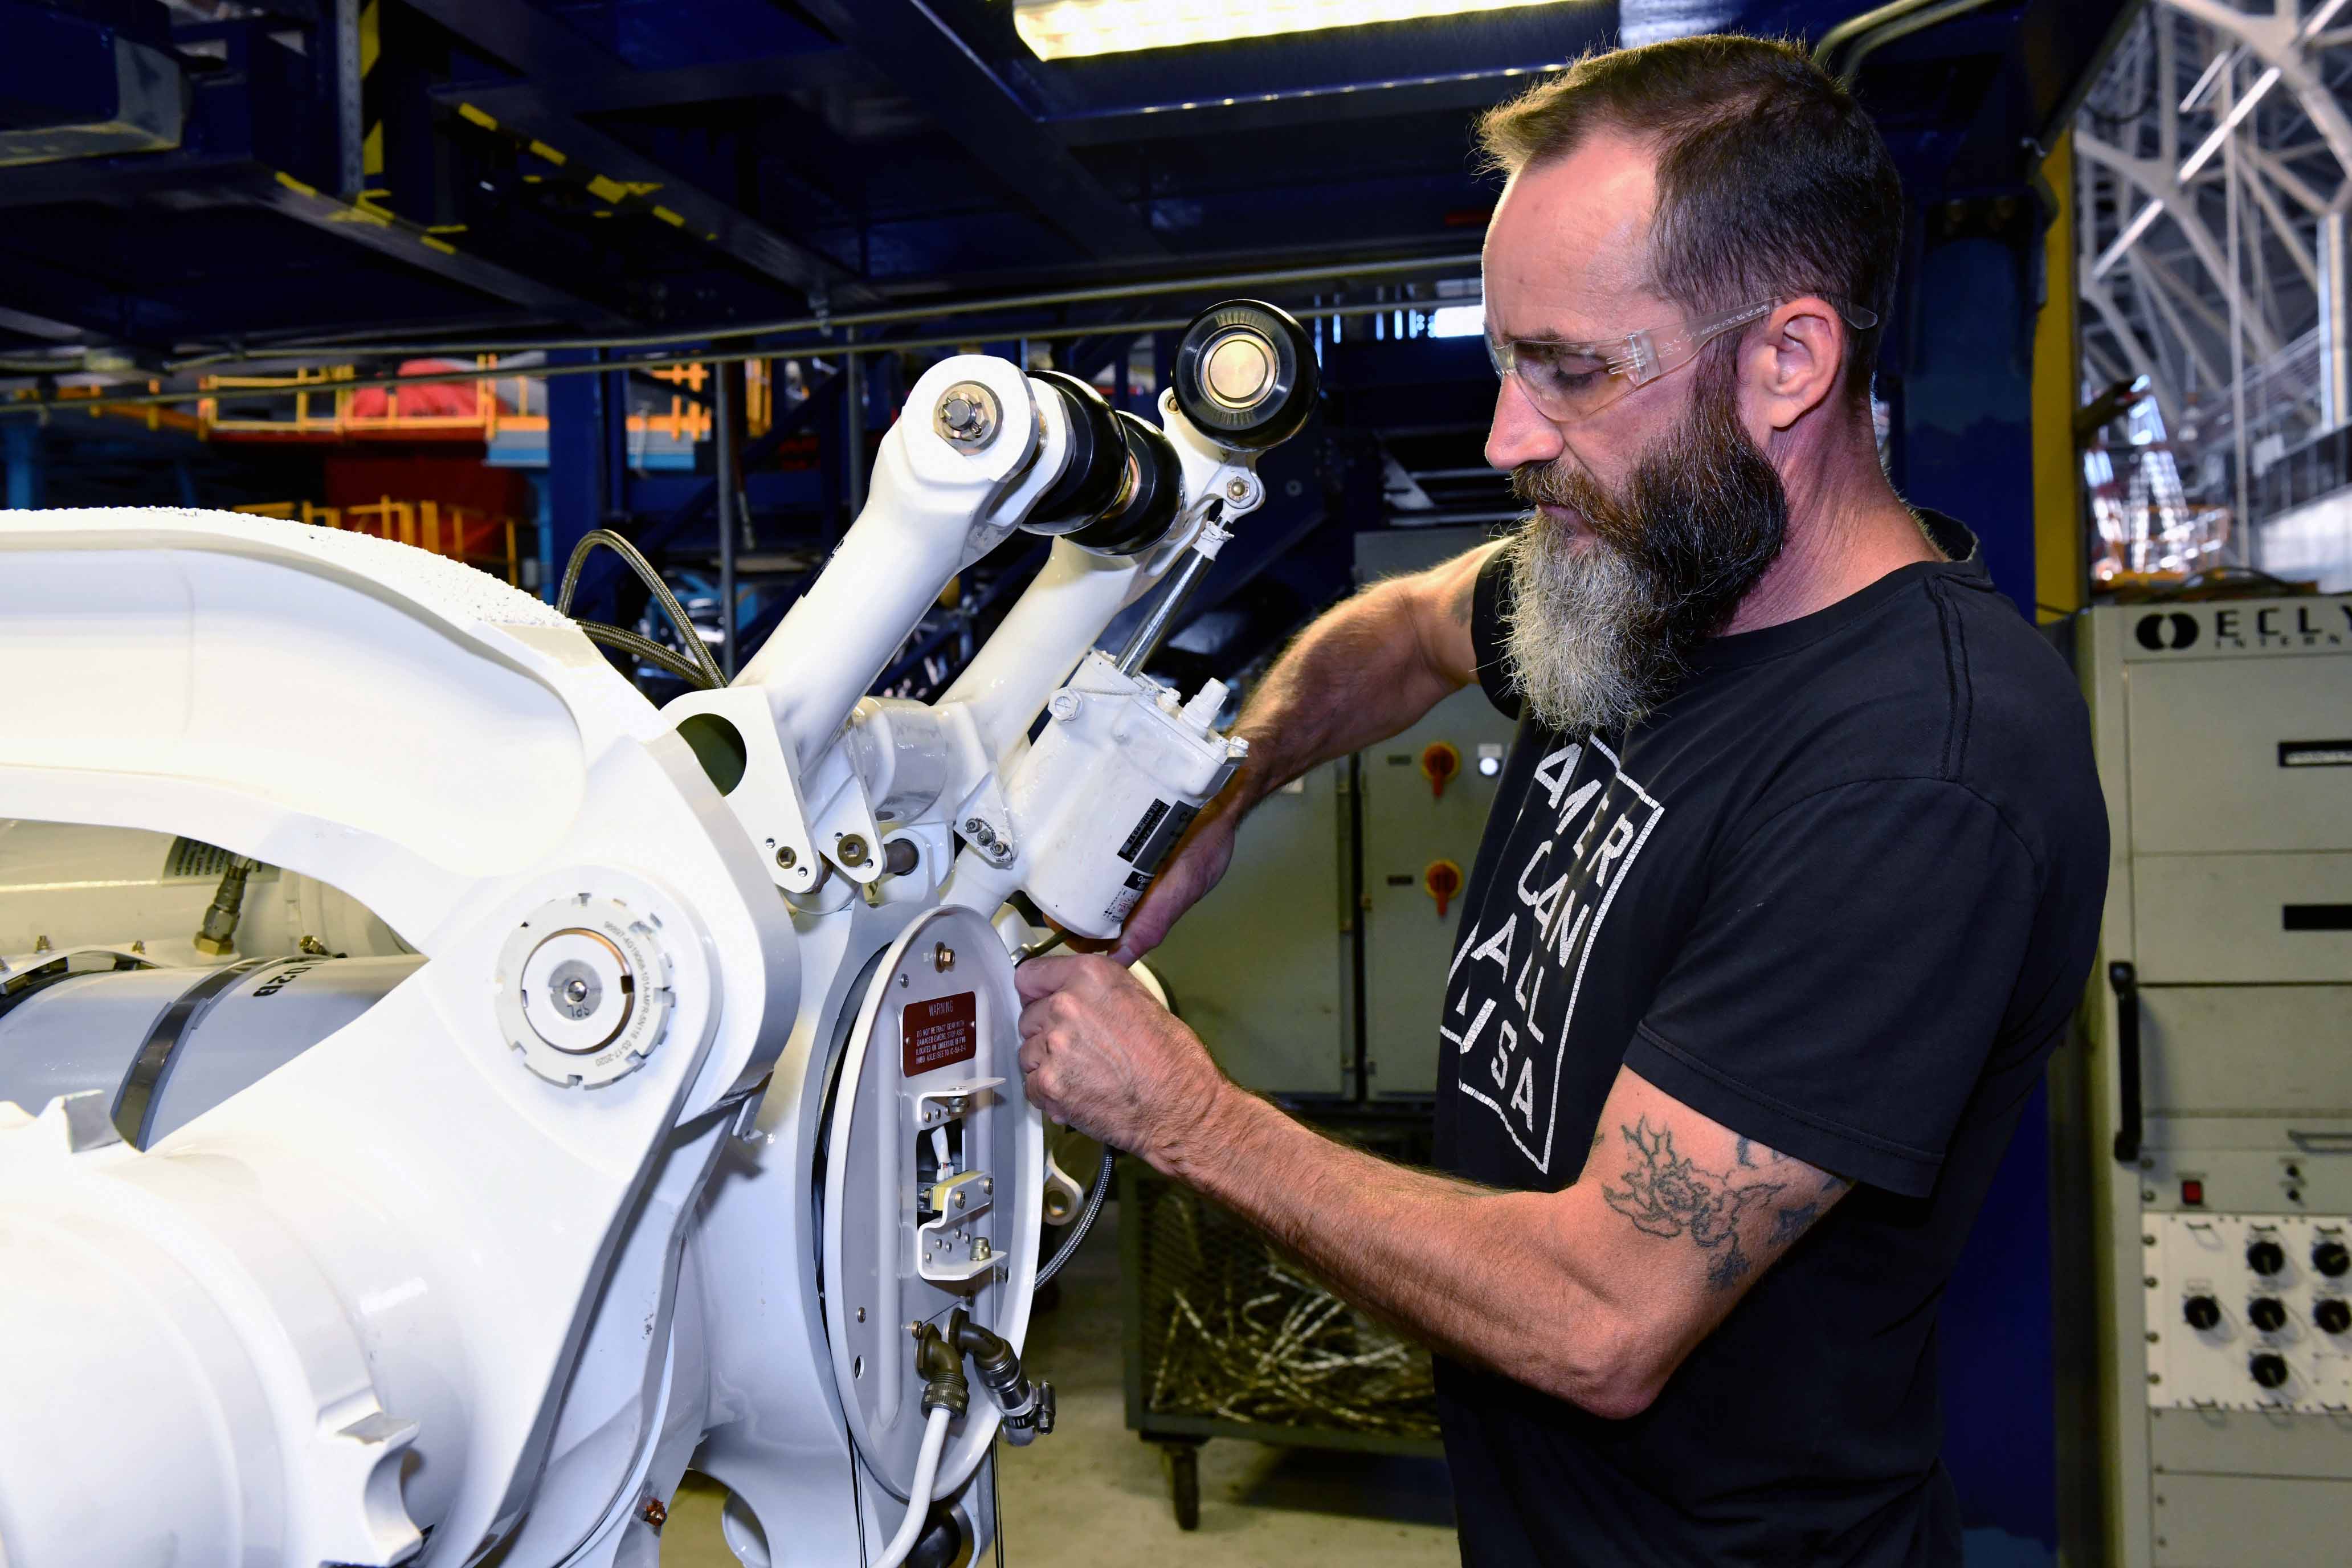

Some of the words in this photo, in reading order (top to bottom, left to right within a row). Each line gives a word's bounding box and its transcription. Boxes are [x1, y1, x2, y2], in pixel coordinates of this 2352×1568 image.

[567, 1004, 590, 1017] SPL
[929, 1000, 953, 1016] WARNING
[931, 1024, 946, 1035] RETRACT
[947, 1022, 956, 1030] GEAR
[917, 1037, 933, 1047] DAMAGED
[937, 1039, 954, 1050] UNDERSIDE
